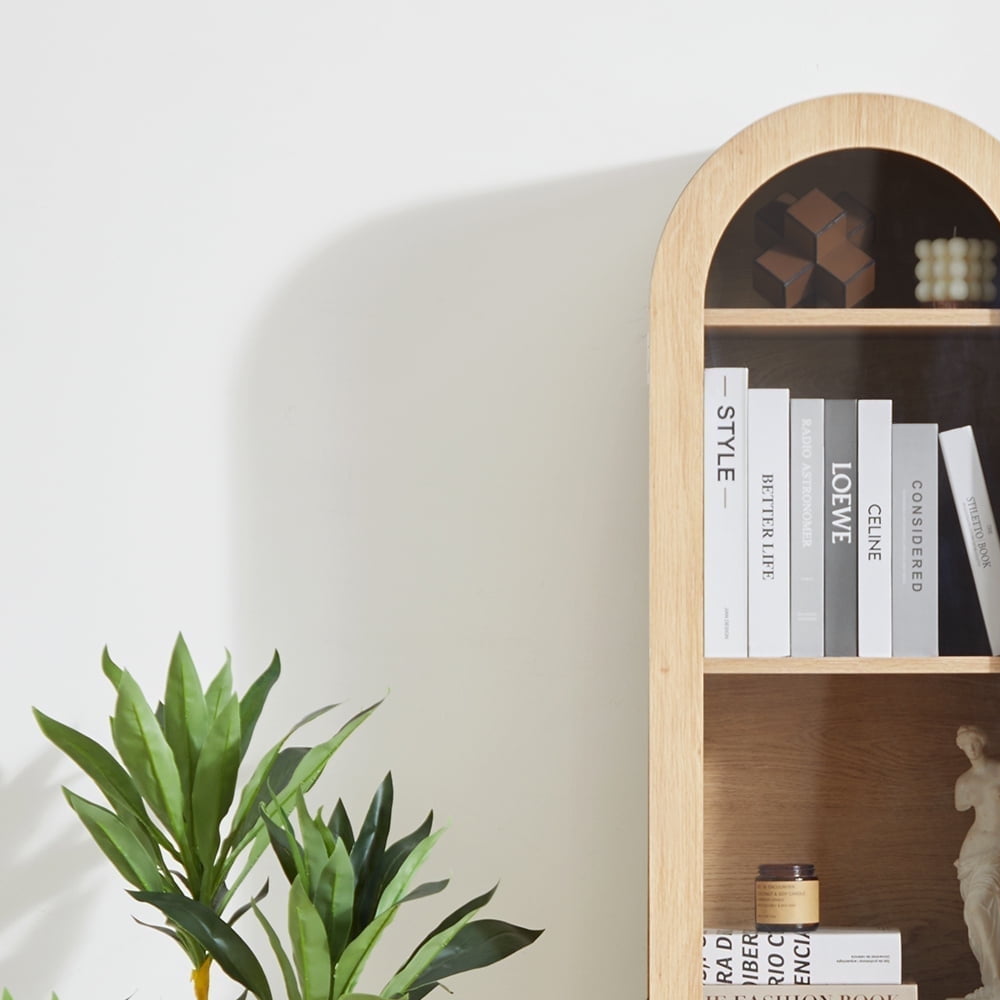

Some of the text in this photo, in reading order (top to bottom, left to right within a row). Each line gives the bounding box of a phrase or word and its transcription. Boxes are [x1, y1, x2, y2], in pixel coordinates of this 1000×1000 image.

[716, 405, 735, 482] STYLE
[801, 418, 812, 548] RADIO ASTRONOMER
[761, 474, 774, 580] BETTER LIFE
[831, 461, 852, 544] LOEWE
[867, 503, 881, 561] CELINE
[911, 480, 923, 593] CONSIDERED
[966, 496, 984, 539] STILETTO
[978, 539, 992, 568] BOOK
[742, 934, 758, 986] IBER
